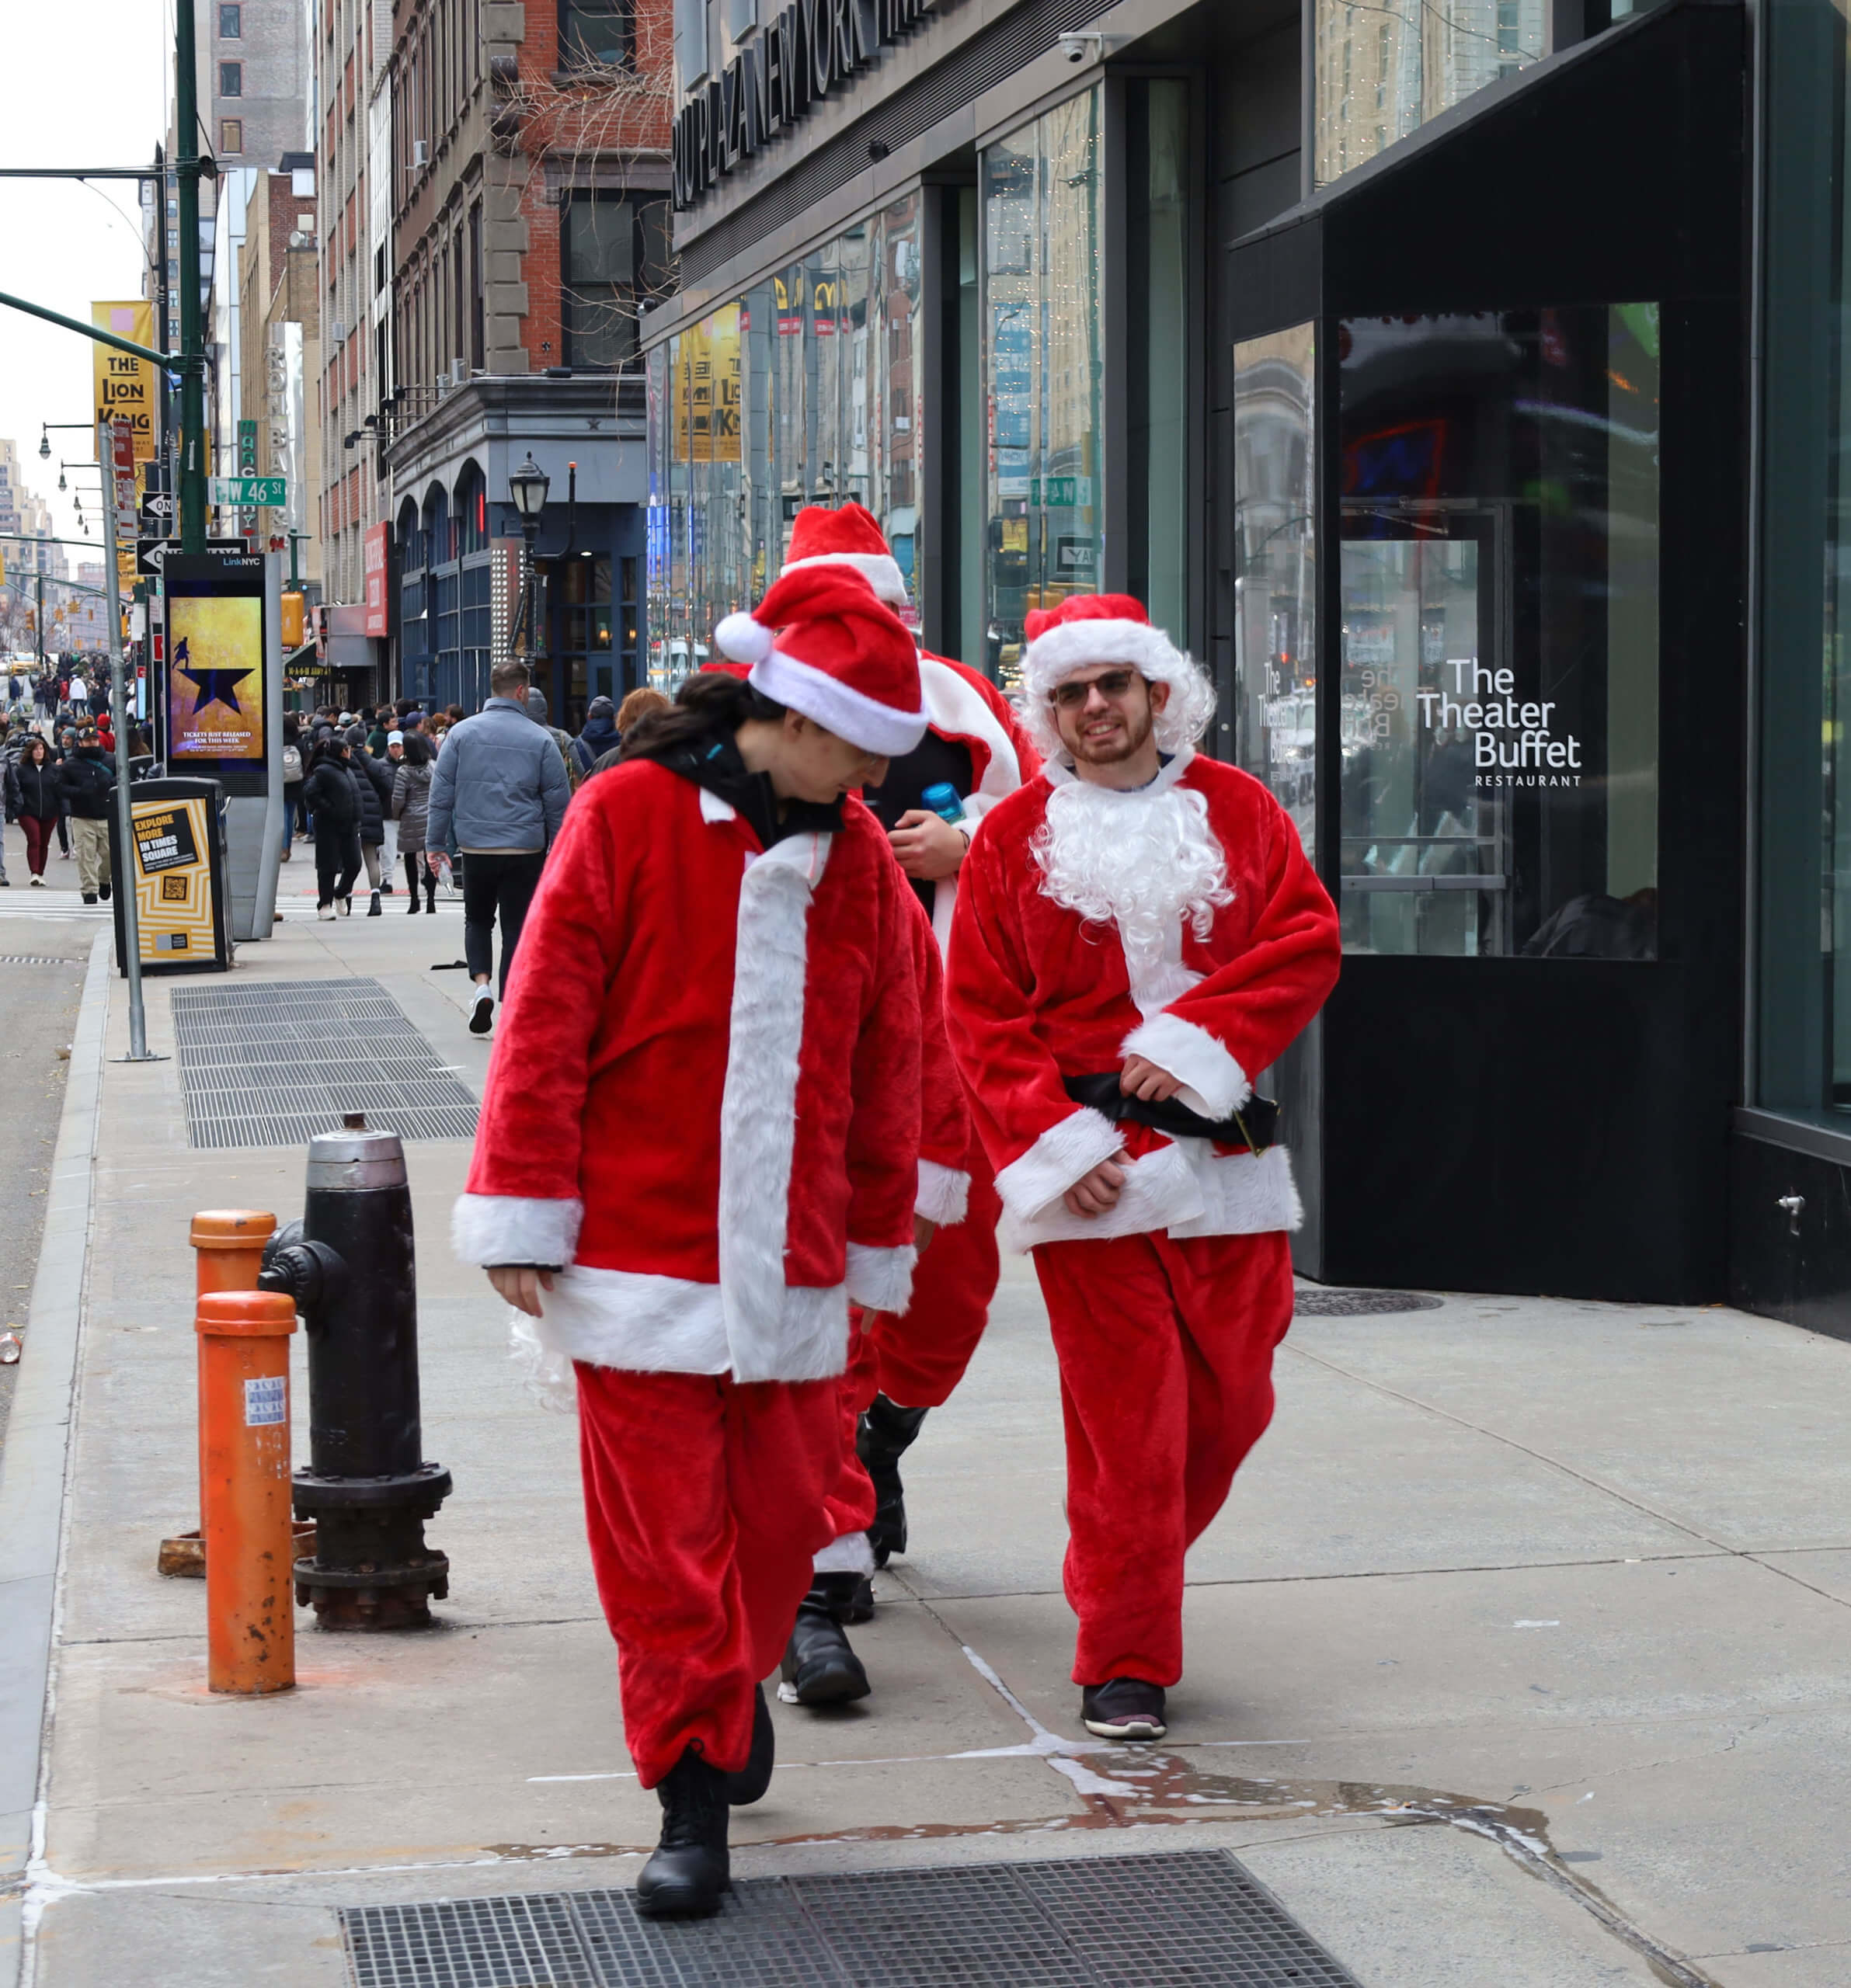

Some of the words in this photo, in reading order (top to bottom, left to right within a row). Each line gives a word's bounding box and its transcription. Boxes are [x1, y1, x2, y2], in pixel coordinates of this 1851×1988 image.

[108, 357, 139, 371] THE
[103, 378, 144, 405] LION
[229, 481, 242, 502] W
[248, 481, 267, 502] 46
[272, 481, 282, 495] St
[156, 501, 172, 511] ON
[223, 557, 260, 566] LinkNYC
[1446, 657, 1515, 695] The
[1416, 691, 1556, 728] Theater
[1475, 729, 1582, 768] Buffet
[1475, 775, 1581, 787] RESTAURANT
[134, 814, 174, 831] EXPLORE
[137, 827, 164, 842] MORE
[139, 841, 151, 852] IN
[150, 835, 178, 850] TIMES
[142, 846, 179, 863] SQUARE
